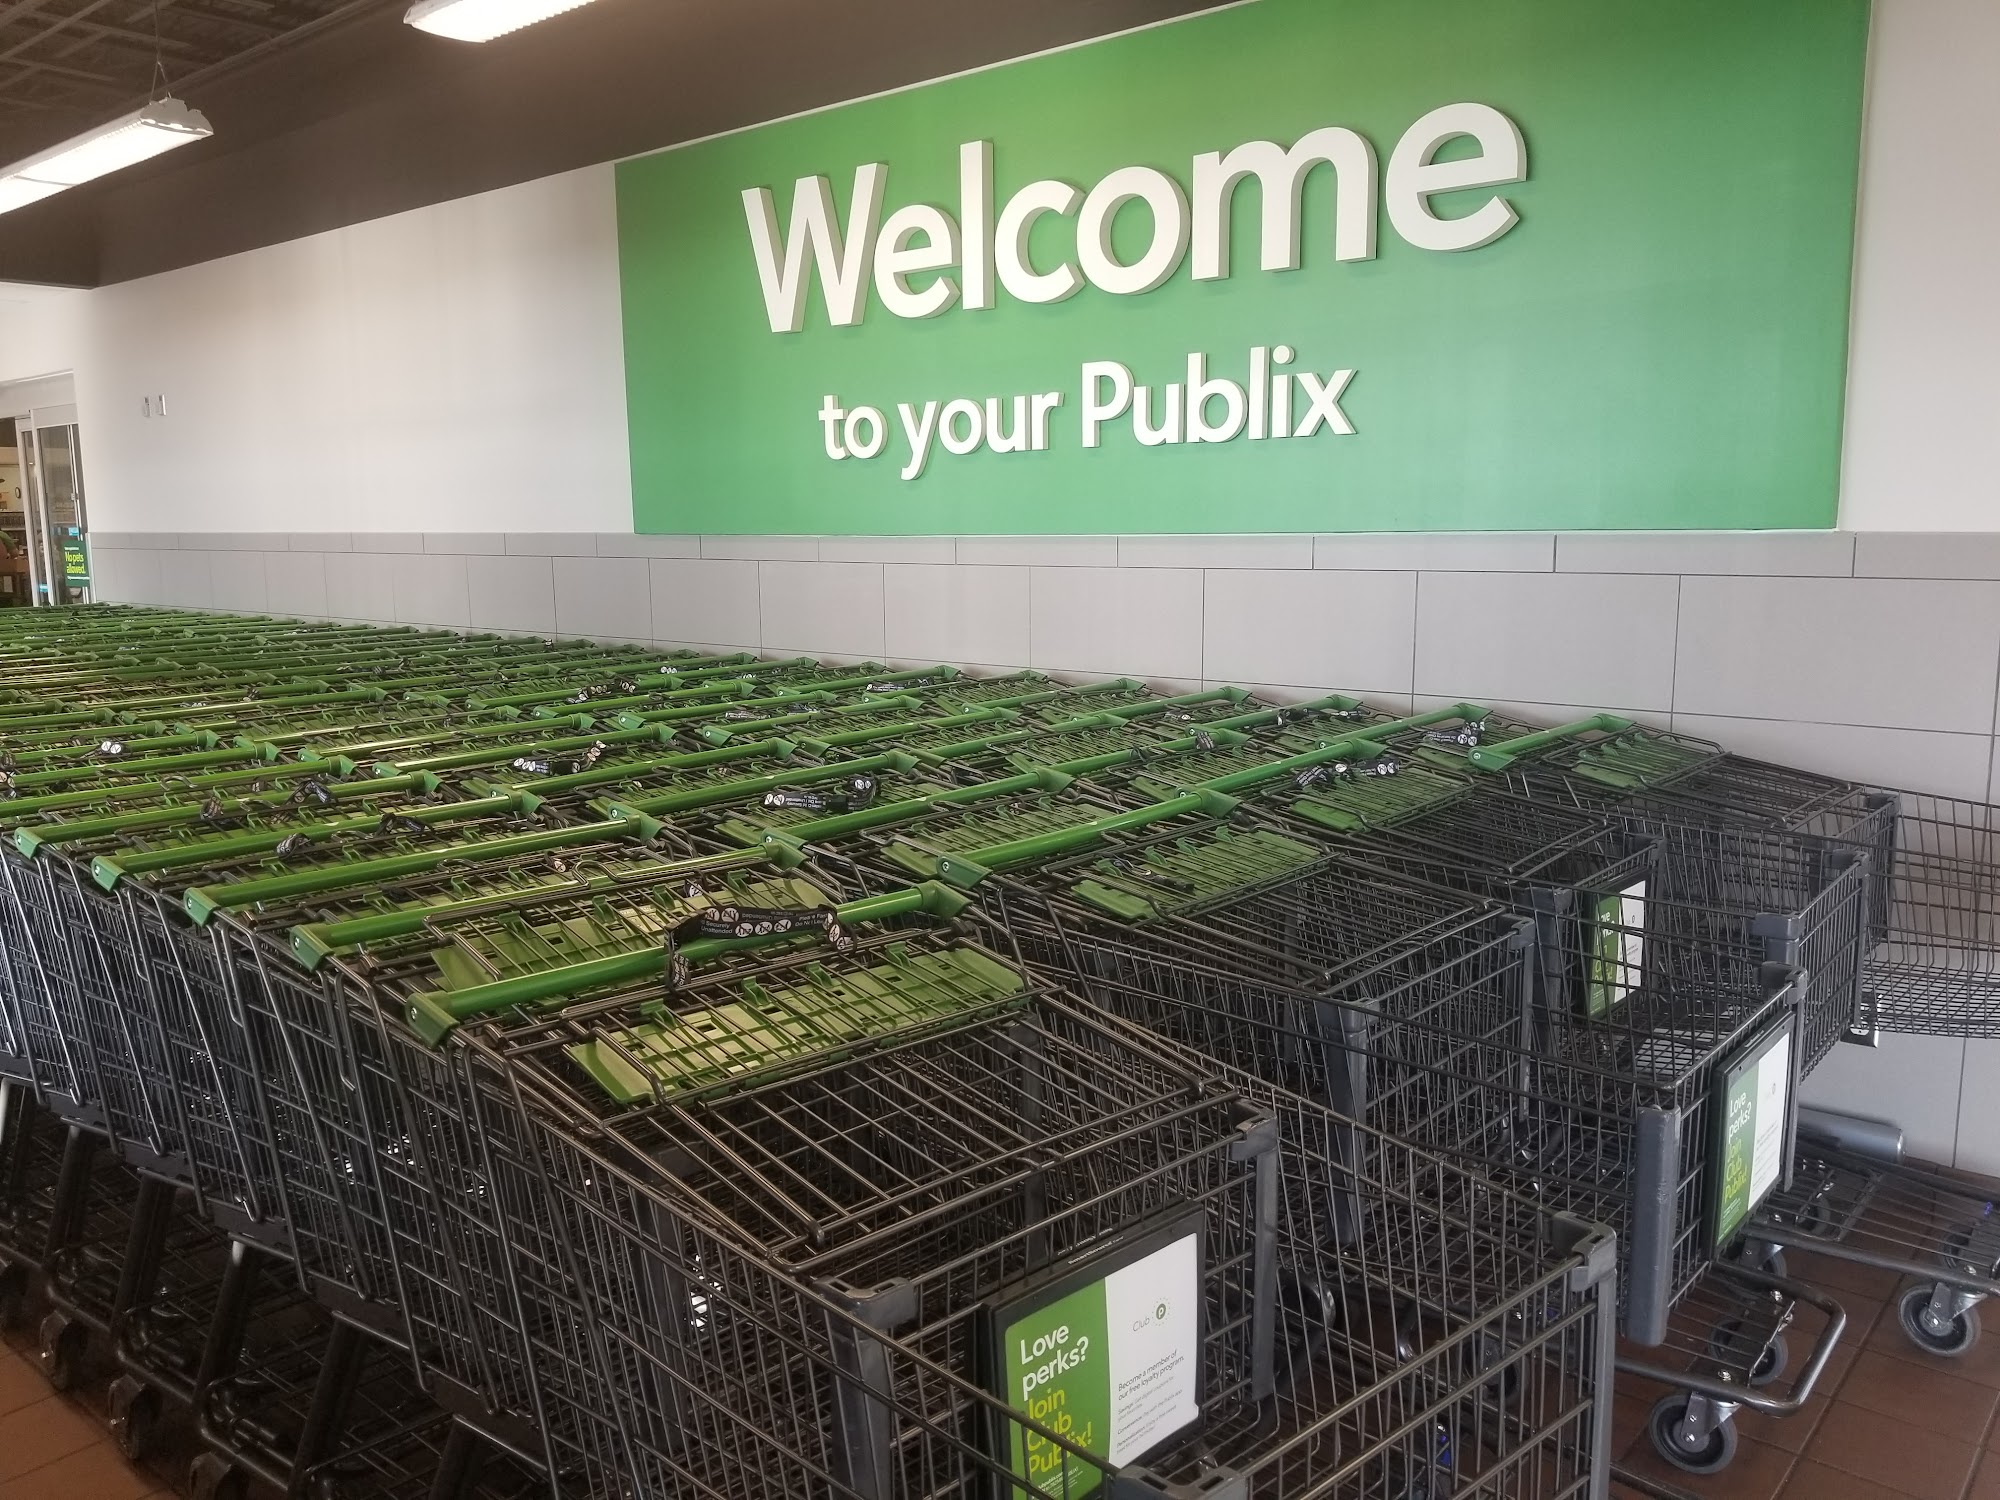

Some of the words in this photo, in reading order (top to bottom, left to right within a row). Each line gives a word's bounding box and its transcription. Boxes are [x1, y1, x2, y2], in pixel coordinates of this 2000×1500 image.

[742, 102, 1527, 333] Welcome
[818, 394, 888, 460] to
[897, 391, 1063, 481] your
[1081, 345, 1357, 449] Publix
[65, 551, 73, 562] No
[72, 552, 84, 565] pets
[1728, 1101, 1752, 1145] perks?
[1729, 1092, 1747, 1118] Love
[1020, 1325, 1069, 1365] Love
[1132, 1316, 1150, 1332] Club
[1022, 1336, 1089, 1402] perks?
[1118, 1373, 1142, 1392] Become
[1146, 1354, 1171, 1374] member
[1171, 1348, 1177, 1359] of
[1118, 1390, 1129, 1401] our
[1129, 1383, 1141, 1394] free
[1141, 1370, 1159, 1386] loyalty
